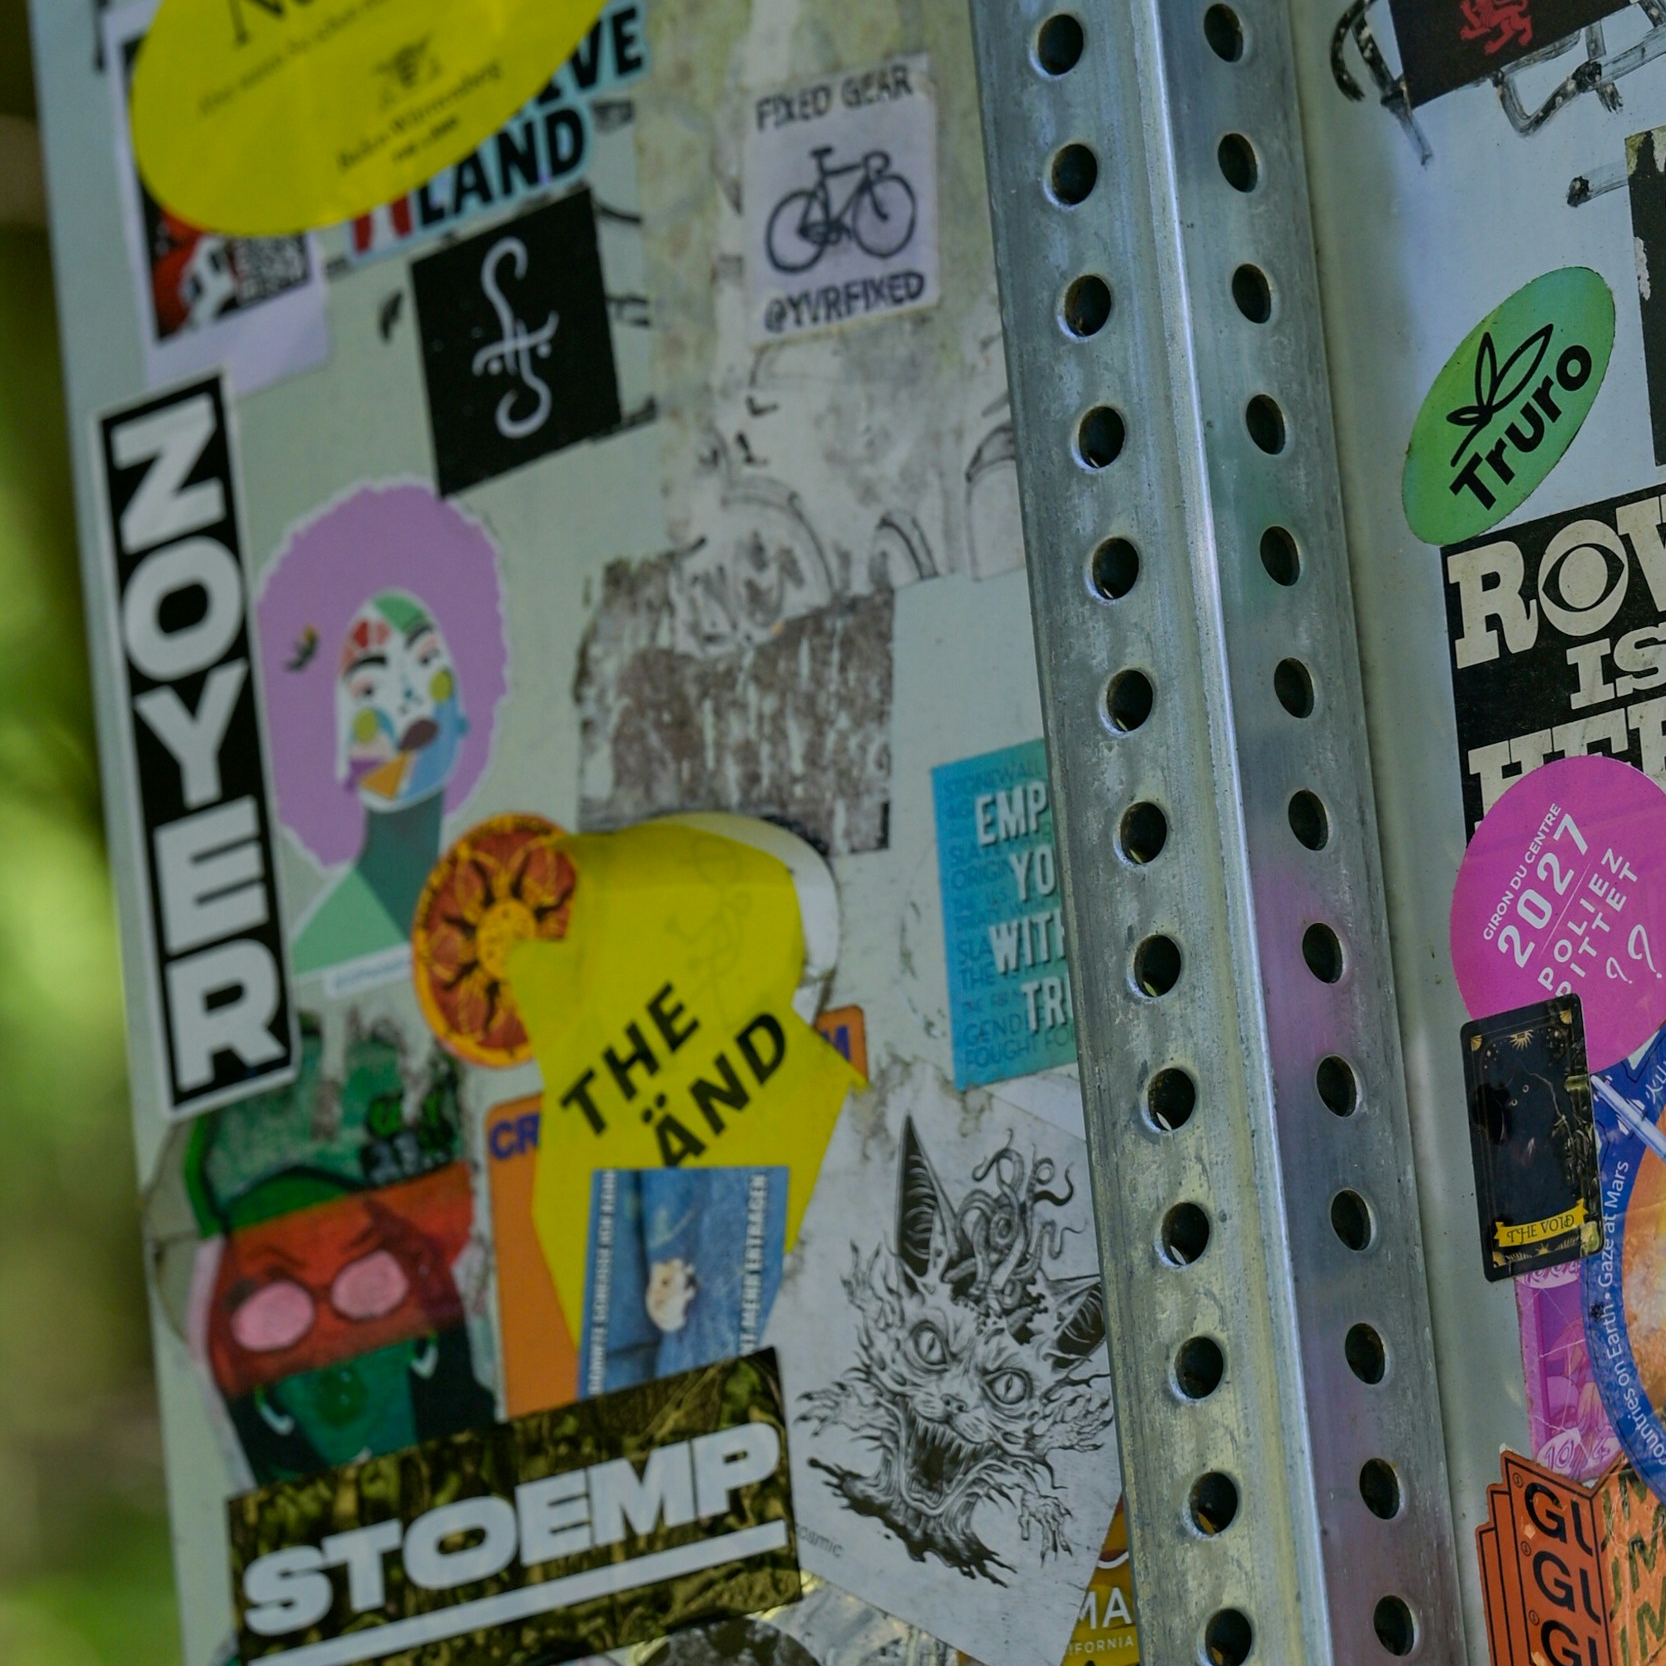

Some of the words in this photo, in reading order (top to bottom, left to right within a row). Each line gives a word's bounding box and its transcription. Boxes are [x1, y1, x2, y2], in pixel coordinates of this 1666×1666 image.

[755, 92, 832, 131] FIXED
[839, 65, 914, 113] GEAR
[763, 271, 926, 334] @YVRFIXED
[1450, 343, 1594, 511] Truro
[1481, 889, 1516, 941] GIRON
[1508, 862, 1531, 892] DU
[1522, 801, 1562, 864] CENTRE
[1497, 813, 1588, 967] 2027
[1537, 847, 1623, 988] POLIEZ
[1556, 866, 1640, 997] PITTET
[559, 983, 701, 1138] THE
[1600, 1159, 1630, 1208] Mars
[1507, 1222, 1537, 1246] THE
[1600, 1209, 1618, 1233] at
[1596, 1235, 1617, 1287] Gaze
[1598, 1304, 1630, 1358] Earth
[1609, 1359, 1632, 1387] on
[241, 1420, 783, 1638] STOEMP
